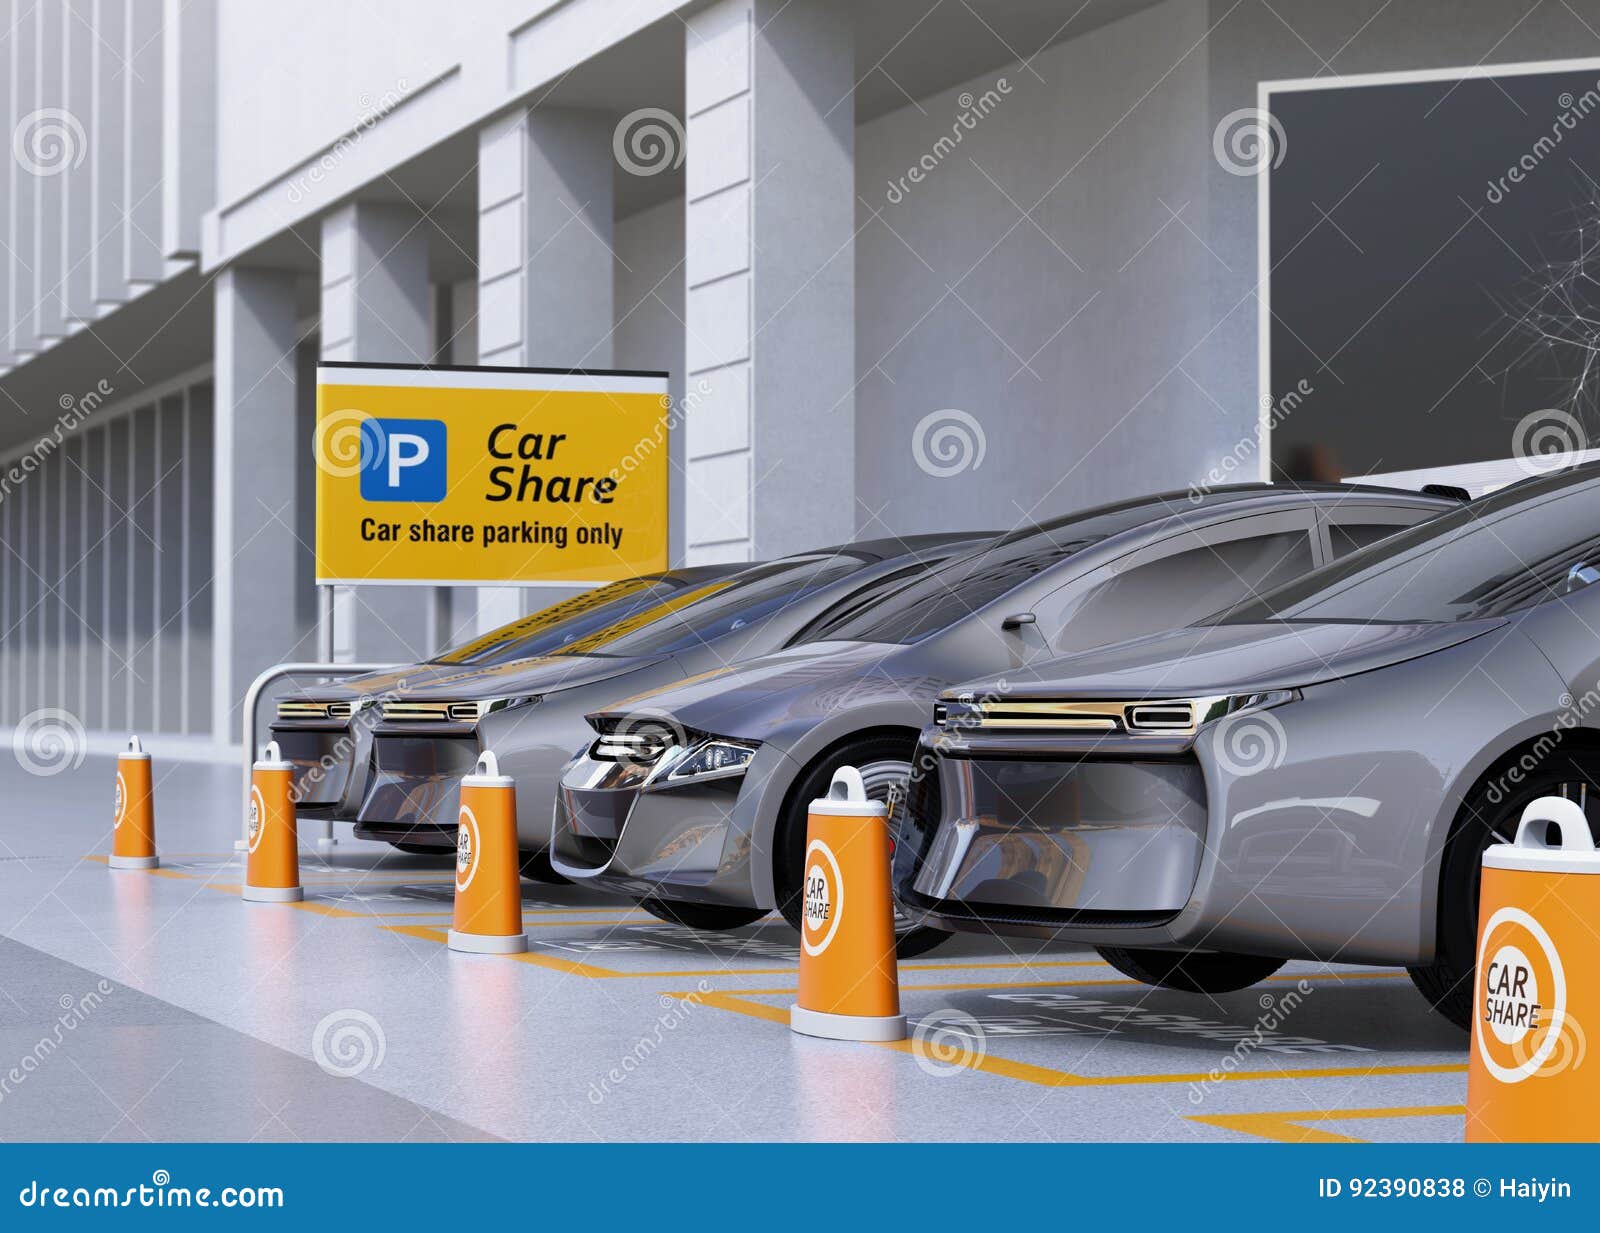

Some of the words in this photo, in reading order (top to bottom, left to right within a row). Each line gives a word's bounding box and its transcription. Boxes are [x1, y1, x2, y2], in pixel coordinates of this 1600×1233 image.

[388, 433, 430, 487] P
[487, 423, 566, 461] Car
[485, 464, 618, 504] Share
[361, 517, 401, 542] Car
[409, 518, 474, 543] share
[483, 521, 568, 548] parking
[576, 522, 623, 549] only
[806, 876, 825, 900] CAR
[1487, 962, 1529, 999] CAR
[1485, 997, 1541, 1029] SHARE
